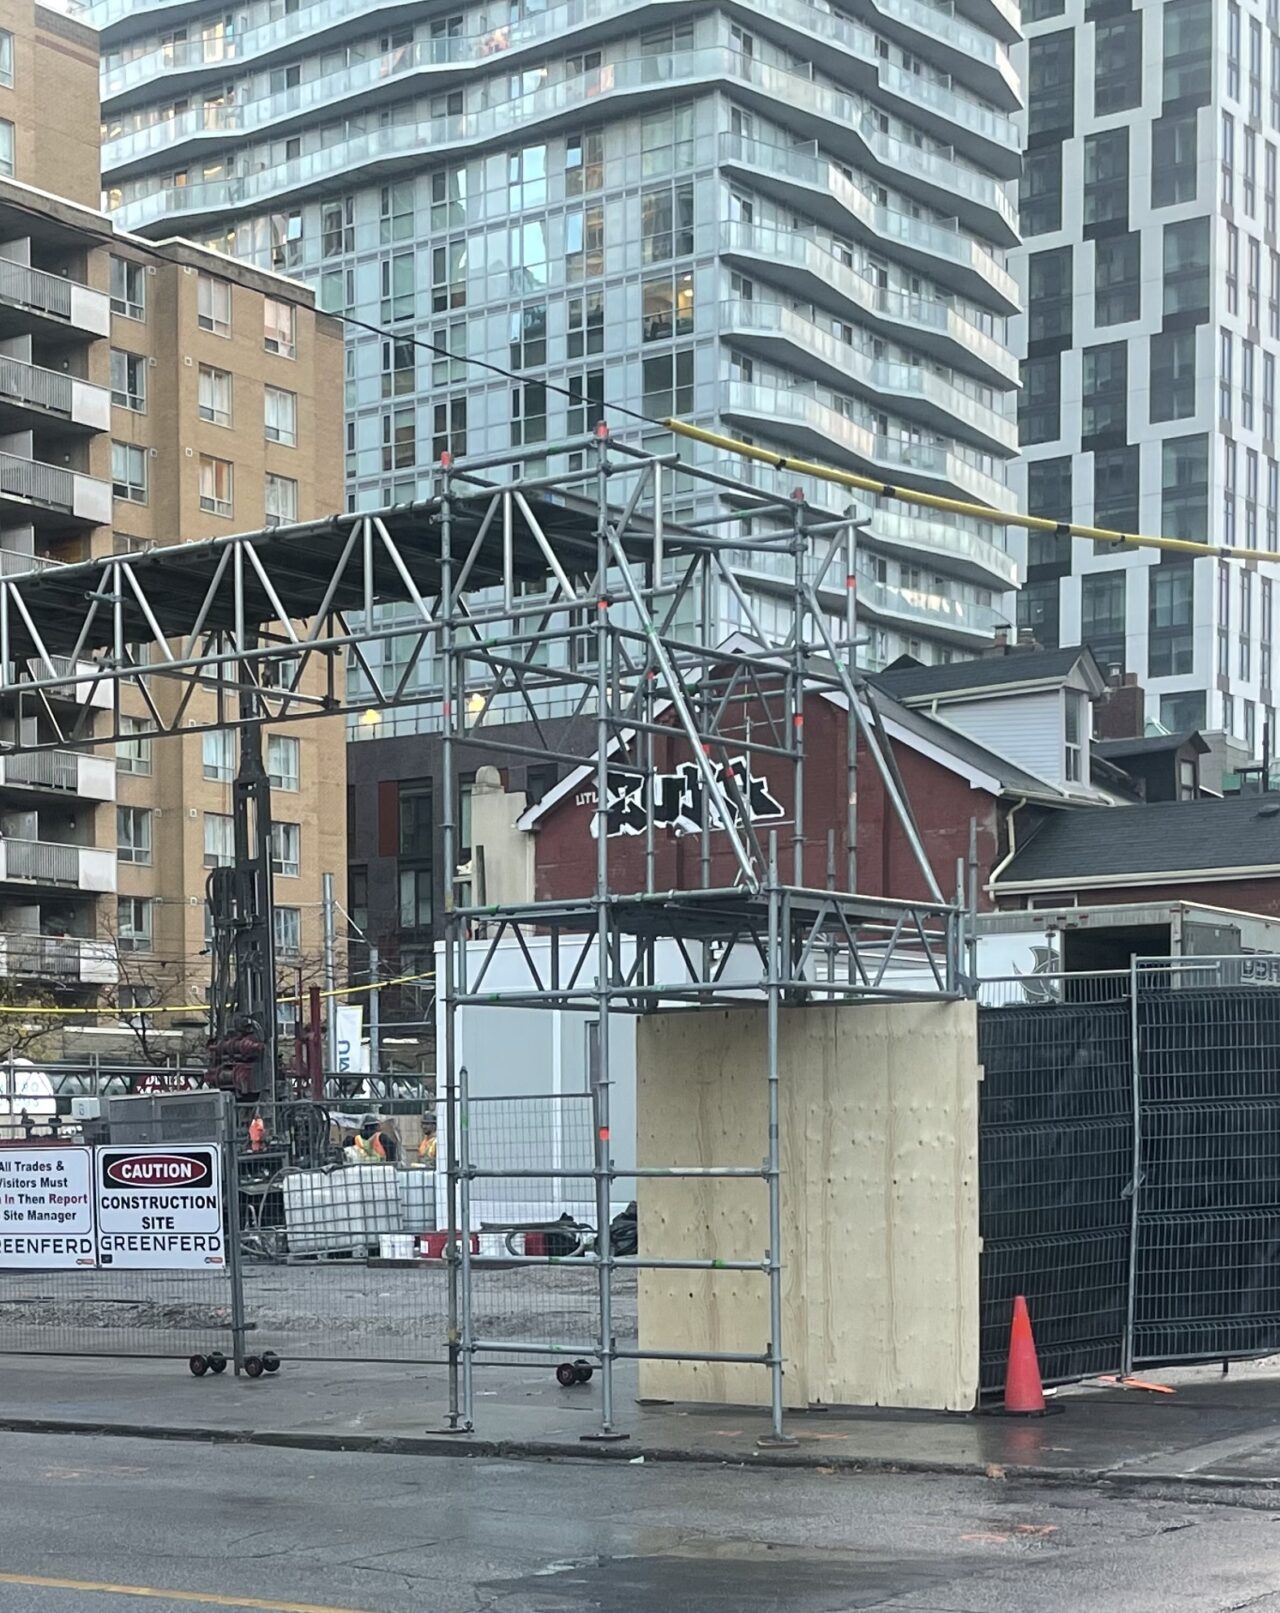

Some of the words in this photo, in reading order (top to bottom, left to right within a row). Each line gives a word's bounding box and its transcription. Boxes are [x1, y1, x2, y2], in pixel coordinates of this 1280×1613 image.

[14, 1160, 52, 1172] Trades
[56, 1160, 64, 1171] &
[121, 1163, 192, 1179] CAUTION
[40, 1177, 68, 1188] Must
[4, 1194, 15, 1204] In
[18, 1194, 45, 1204] Then
[48, 1193, 88, 1206] Report
[101, 1195, 217, 1210] CONSTRUCTION
[3, 1210, 24, 1221] Site
[27, 1210, 77, 1223] Manager
[141, 1216, 175, 1230] SITE
[100, 1235, 221, 1252] GREENFERD
